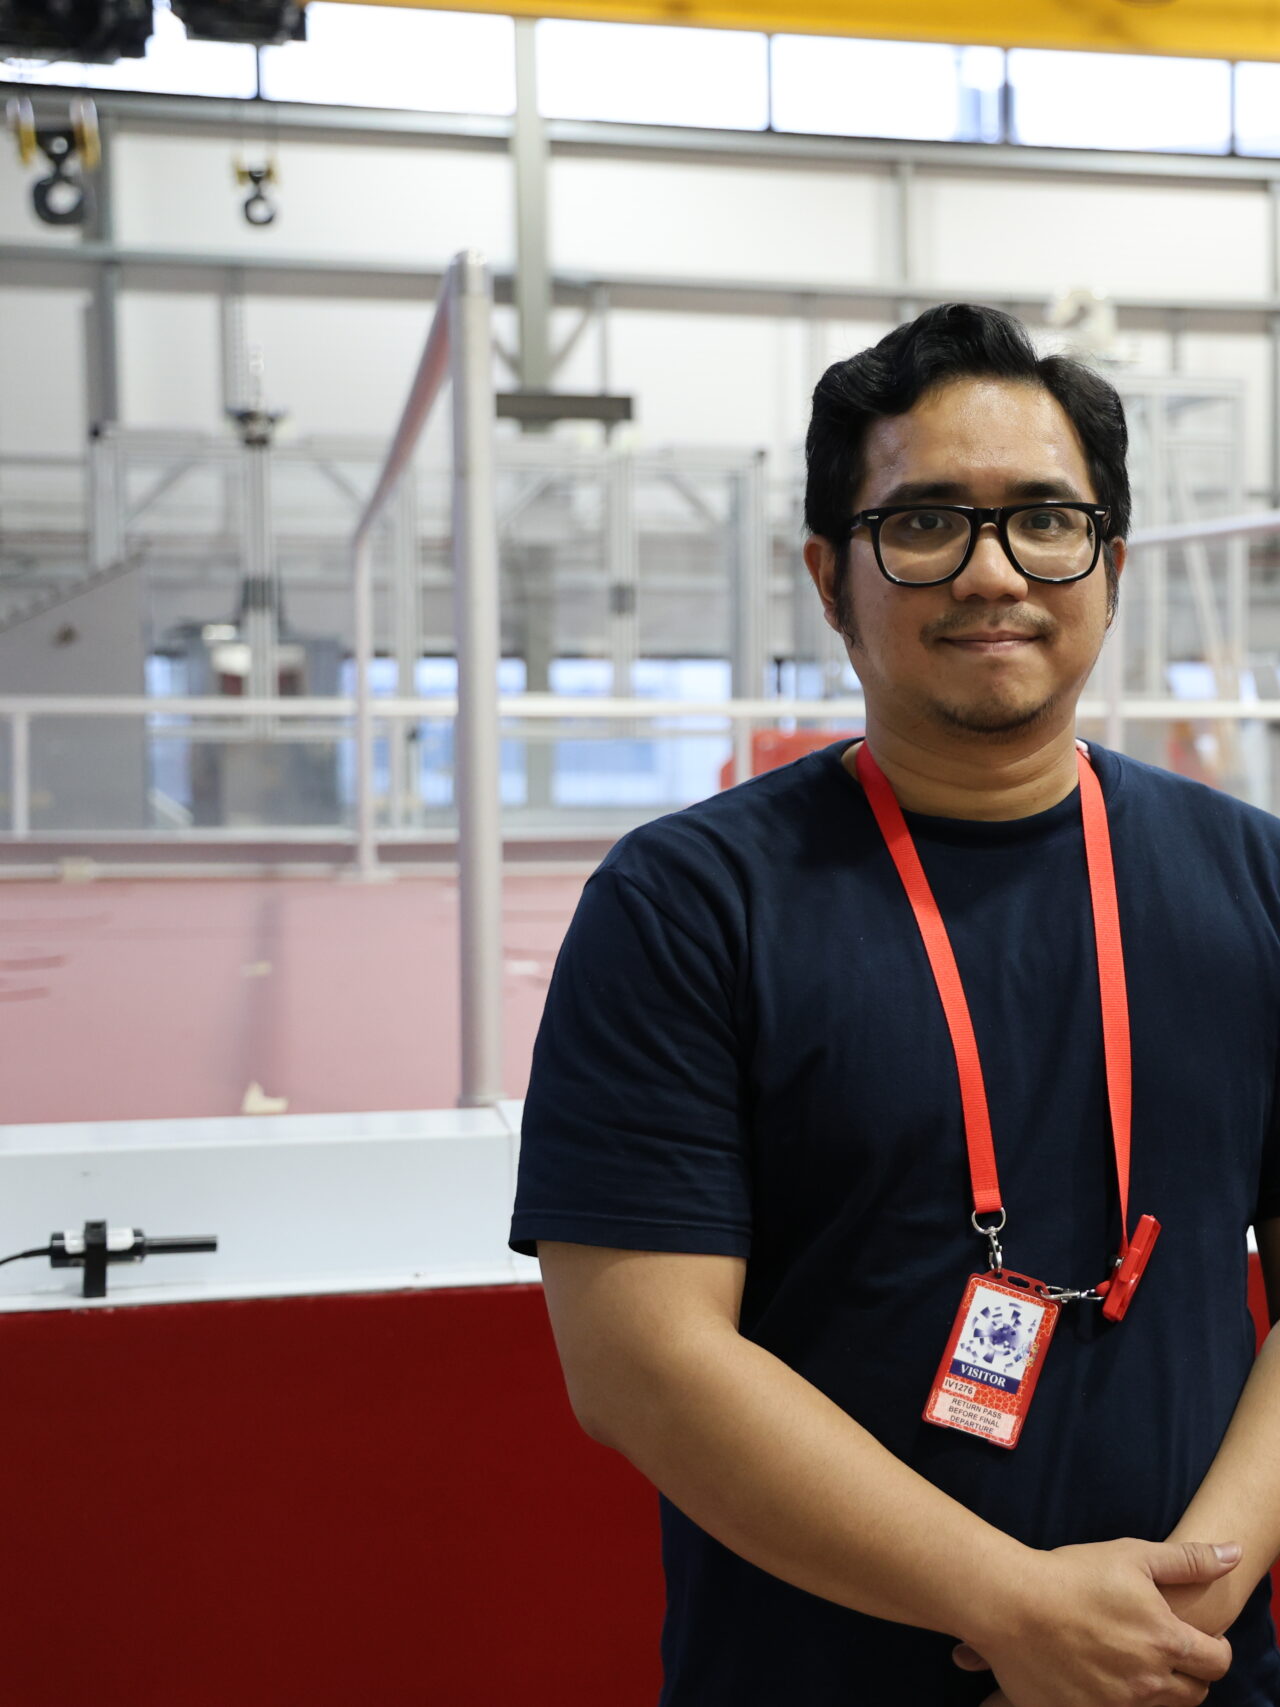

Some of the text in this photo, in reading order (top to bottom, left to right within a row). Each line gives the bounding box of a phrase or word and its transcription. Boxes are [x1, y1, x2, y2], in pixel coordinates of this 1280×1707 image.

[961, 1364, 1006, 1387] VISITOR
[944, 1379, 973, 1395] IV1276
[948, 1406, 1000, 1428] BEFORE FINAL
[952, 1398, 1002, 1420] RETURN PASS
[950, 1415, 994, 1434] DEPARTURE
